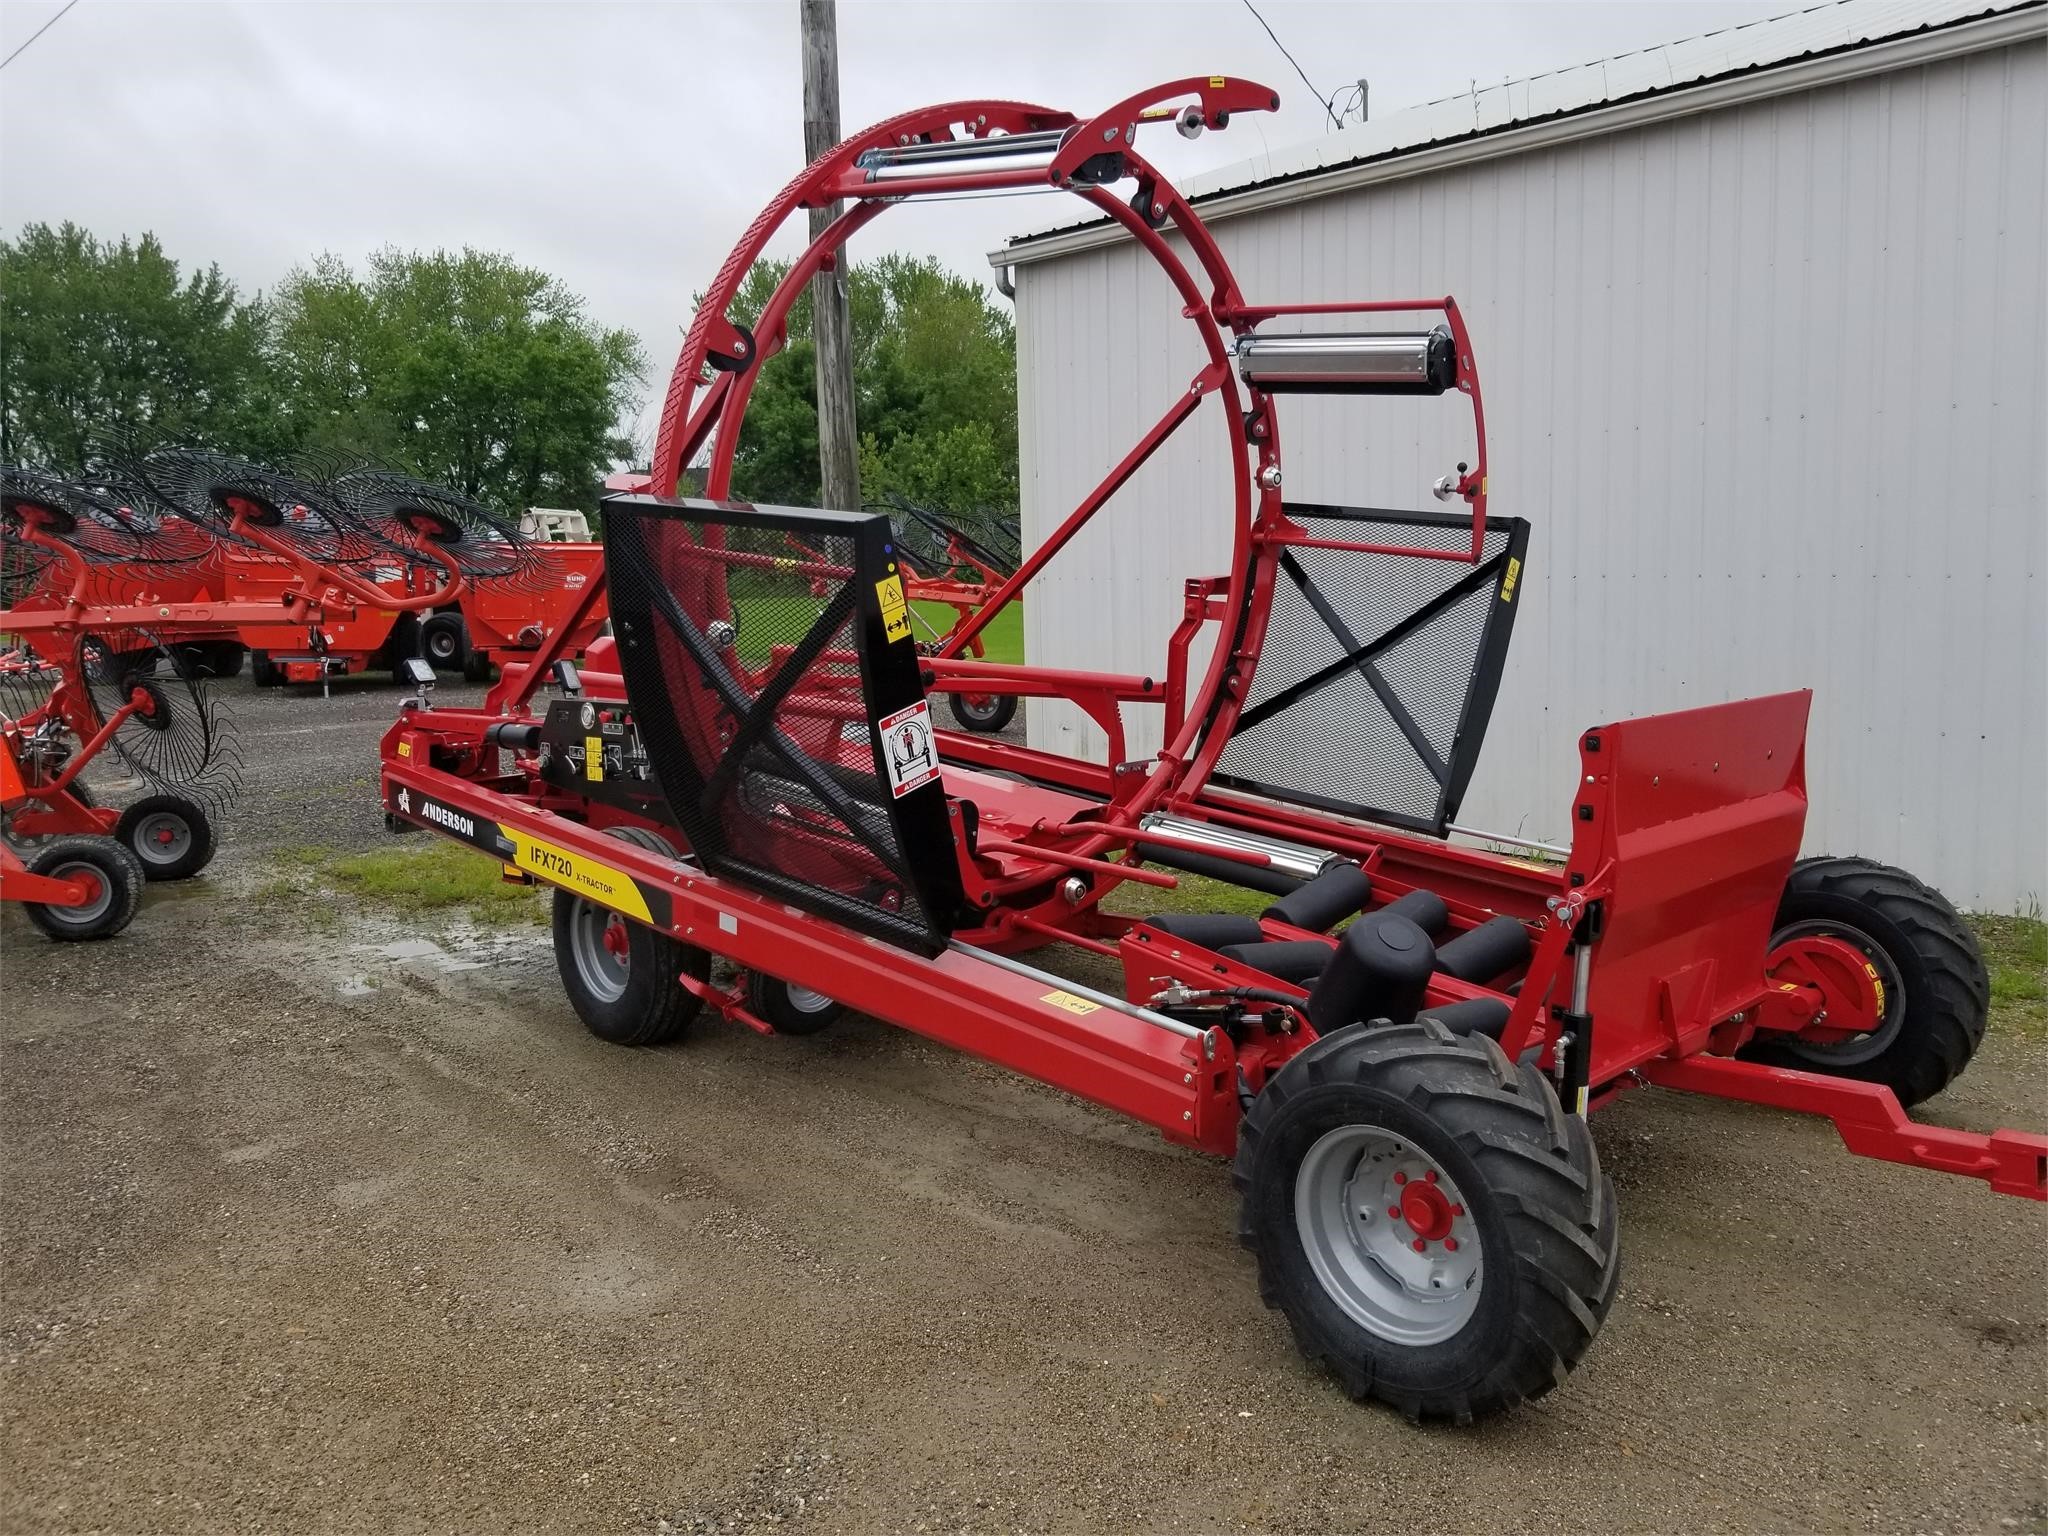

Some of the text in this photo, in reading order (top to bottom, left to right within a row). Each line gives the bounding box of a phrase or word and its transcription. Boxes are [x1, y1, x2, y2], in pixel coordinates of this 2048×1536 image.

[895, 707, 918, 723] DANGER
[908, 772, 931, 789] DANGER
[421, 801, 474, 837] ANDERSON
[530, 846, 573, 878] IFX720
